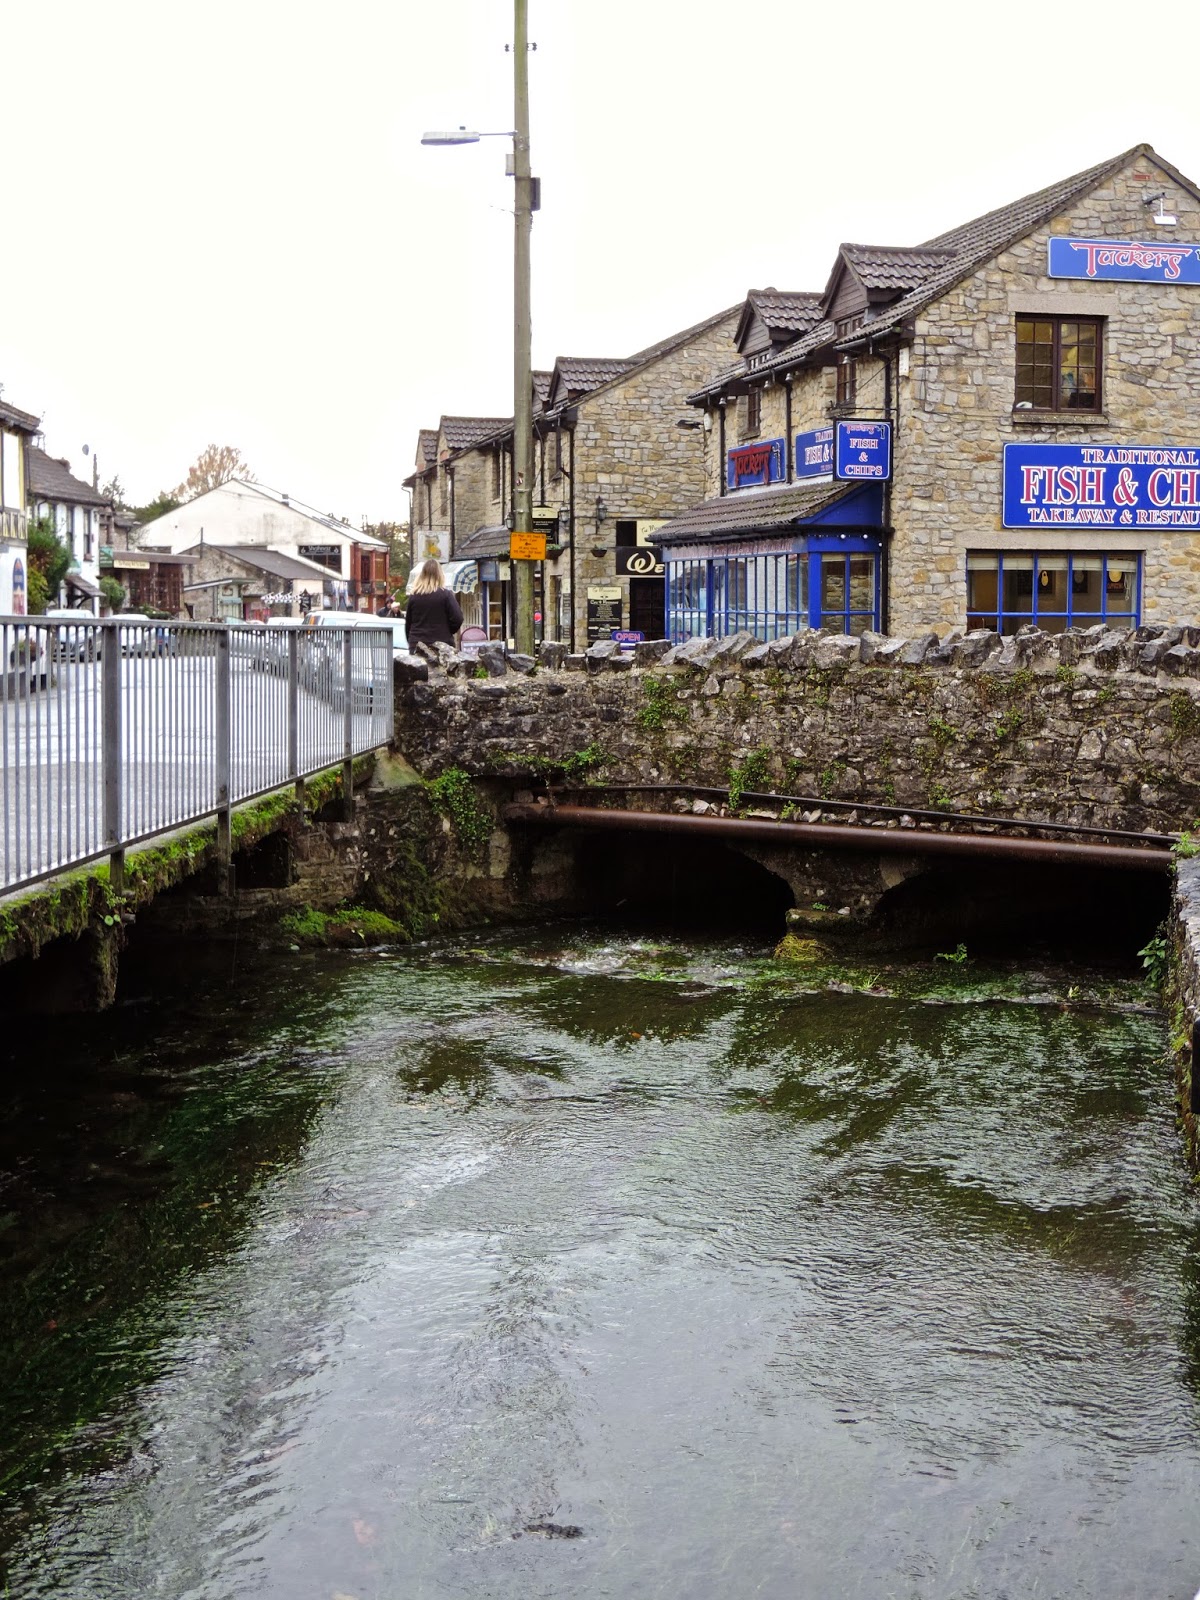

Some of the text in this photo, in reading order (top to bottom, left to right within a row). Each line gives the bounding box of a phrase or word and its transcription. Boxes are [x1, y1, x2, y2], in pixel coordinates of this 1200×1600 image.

[849, 438, 879, 449] FISH
[805, 444, 823, 465] FISH
[858, 451, 869, 462] &
[1081, 448, 1199, 466] TRADITIONAL
[844, 464, 883, 476] CHIPS
[1020, 465, 1200, 507] FISH & CH
[1028, 507, 1200, 525] TAKEAWAY & RESTAU
[615, 632, 641, 642] OPEN
